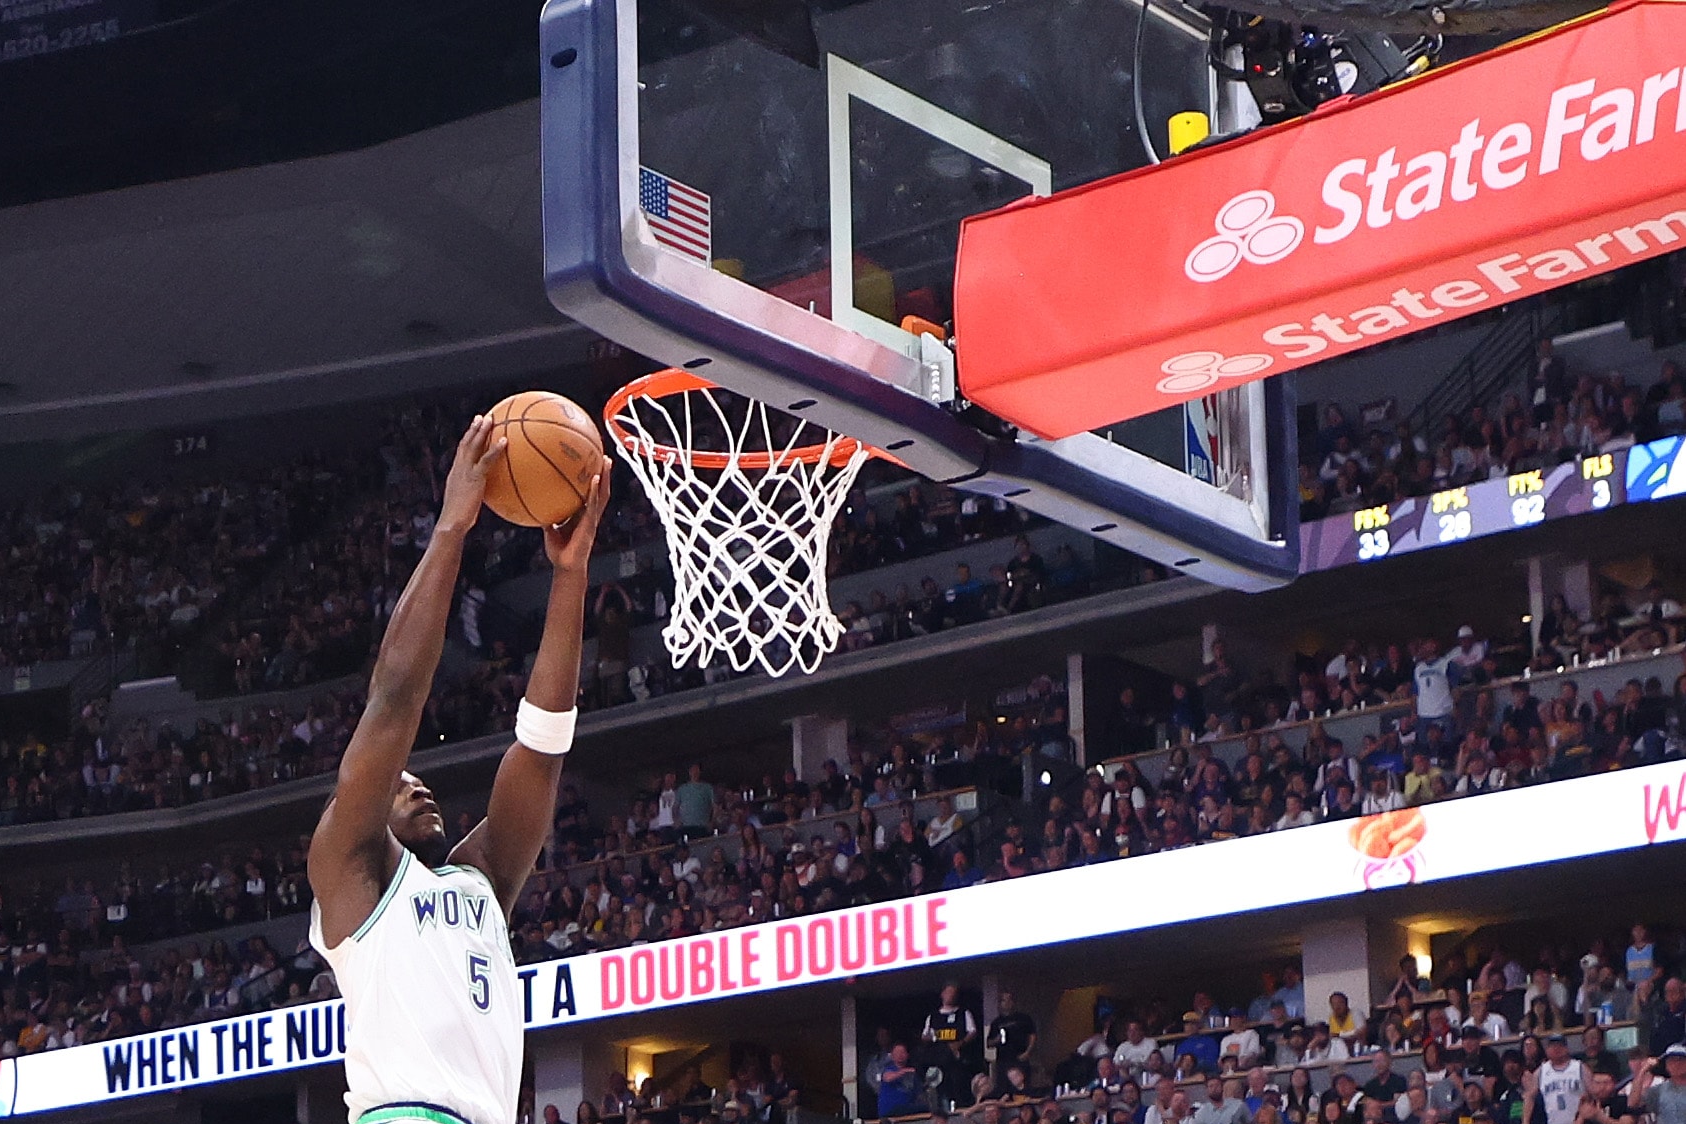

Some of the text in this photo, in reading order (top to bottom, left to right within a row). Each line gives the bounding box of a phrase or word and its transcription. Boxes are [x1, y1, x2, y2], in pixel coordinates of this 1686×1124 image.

[1592, 480, 1611, 508] 3
[1359, 529, 1390, 560] 33
[103, 1030, 199, 1094] WHEN
[211, 1016, 273, 1074] THE
[551, 964, 576, 1018] A
[601, 931, 760, 1011] DOUBLE
[775, 895, 949, 978] DOUBLE
[465, 950, 493, 1015] 5
